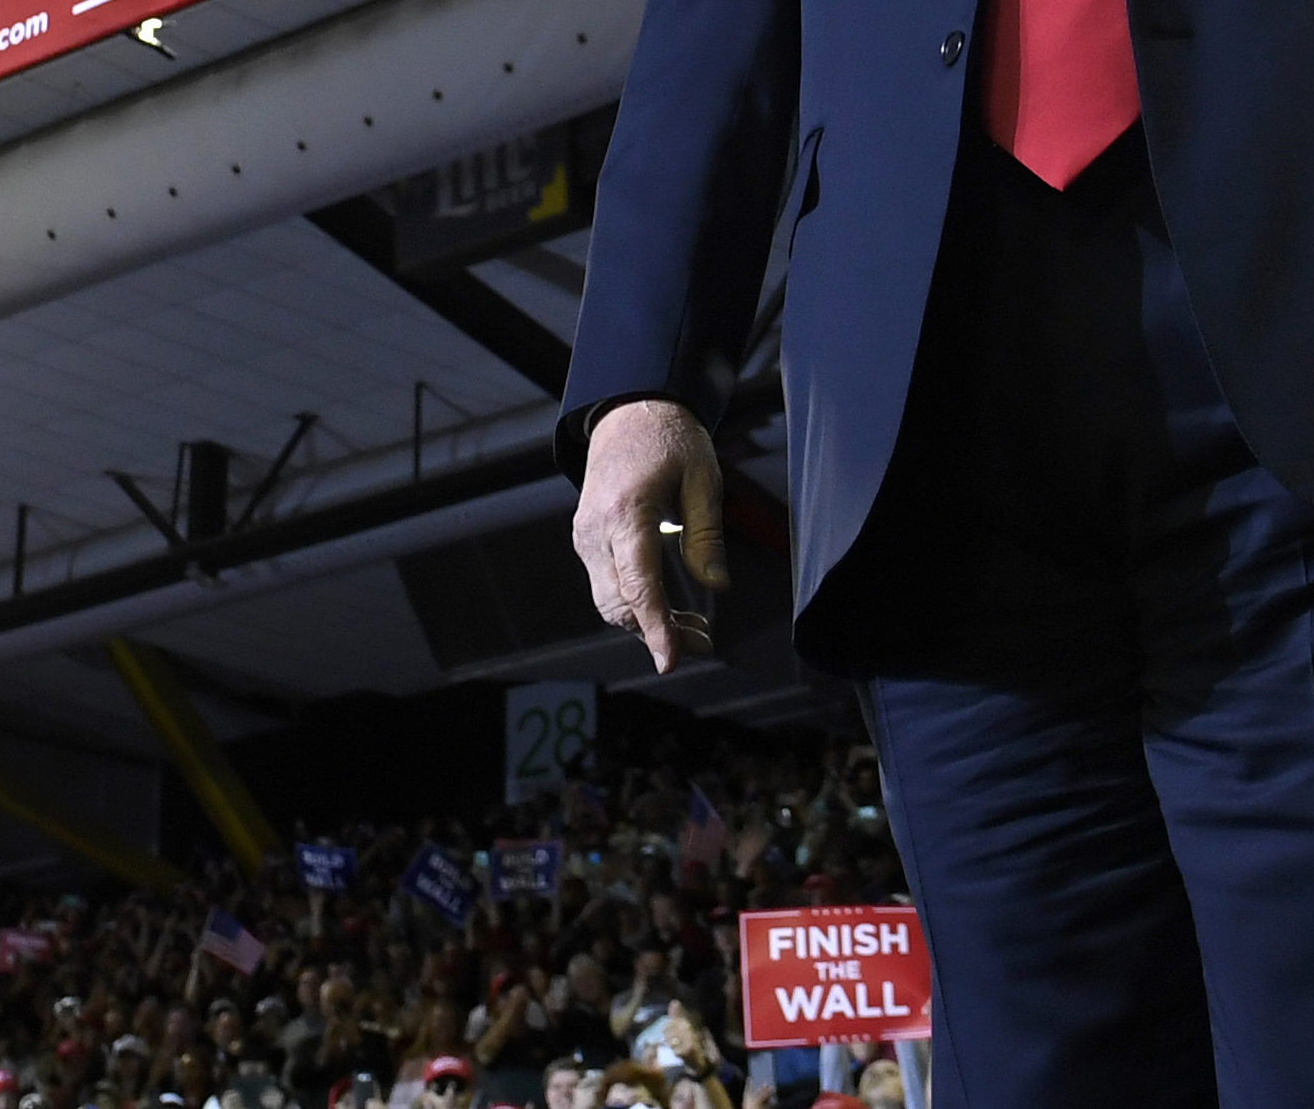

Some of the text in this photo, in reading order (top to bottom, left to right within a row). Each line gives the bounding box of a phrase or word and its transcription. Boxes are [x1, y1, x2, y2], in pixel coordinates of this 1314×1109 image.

[516, 699, 587, 778] 28
[768, 923, 909, 961] FINISH
[814, 960, 861, 981] THE
[775, 981, 910, 1023] WALL
